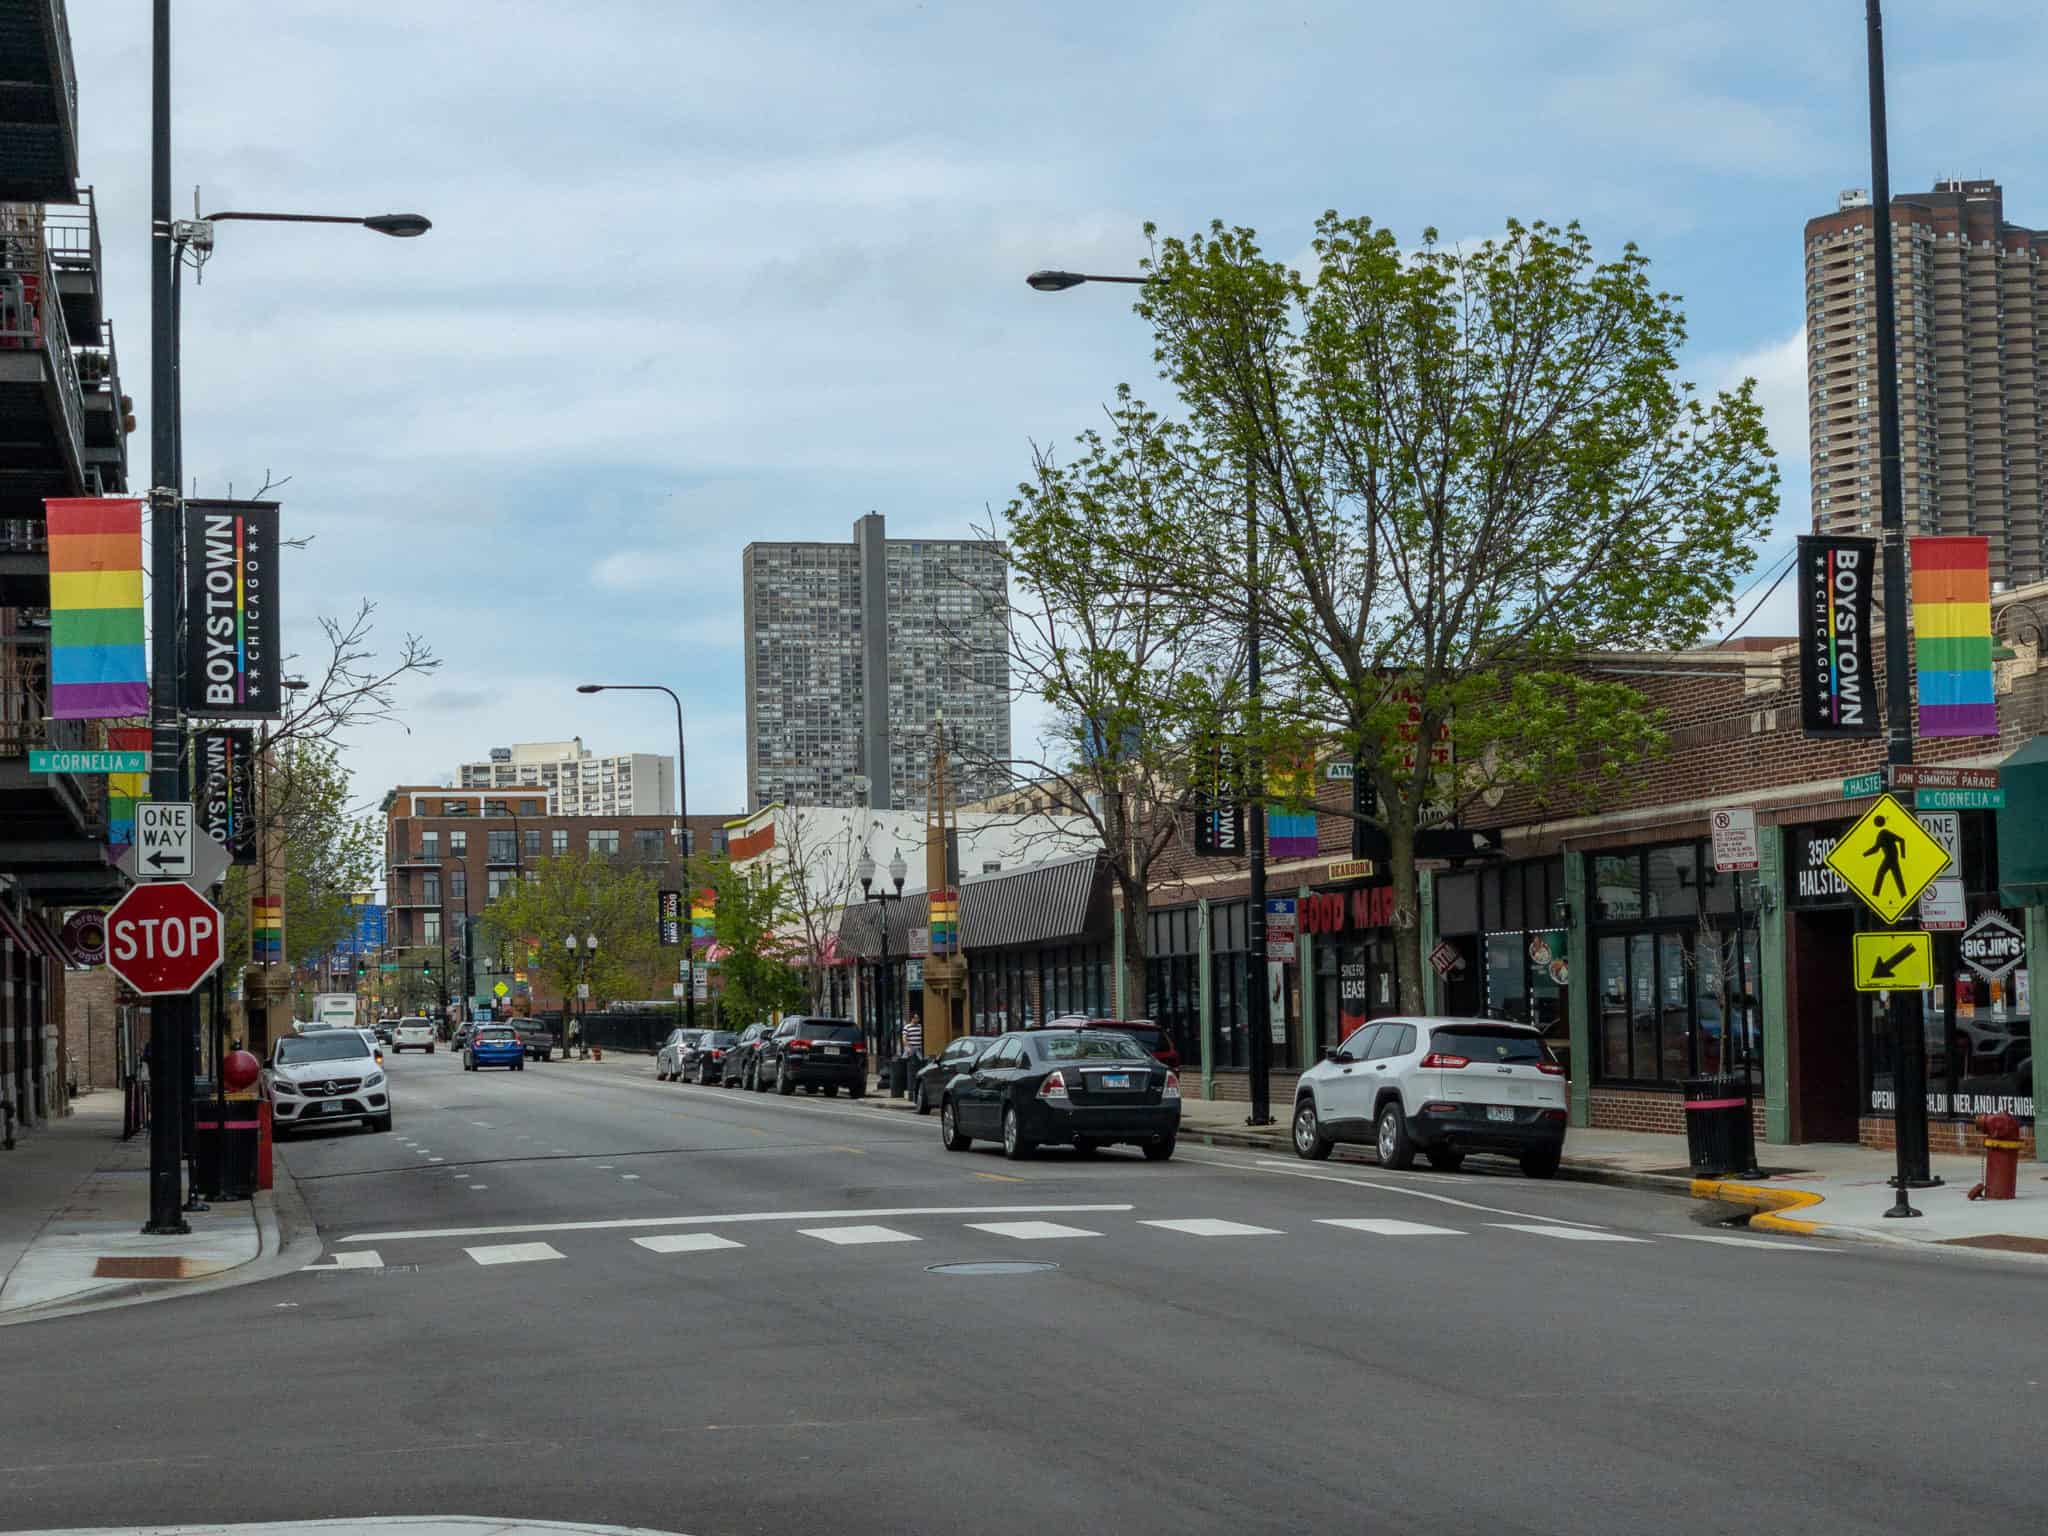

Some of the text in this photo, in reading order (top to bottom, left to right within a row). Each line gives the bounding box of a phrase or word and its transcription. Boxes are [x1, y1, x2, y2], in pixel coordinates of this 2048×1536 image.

[205, 515, 234, 704] BOYSTOWN
[247, 560, 259, 661] CHICAGO
[1815, 590, 1829, 684] CHICAGO
[1835, 549, 1864, 725] BOYSTOWN
[51, 754, 124, 771] CORNELIA
[129, 758, 140, 768] AV
[207, 737, 227, 843] OYSTOWN
[1850, 774, 1881, 794] HALSTE
[1896, 772, 1997, 789] JON SIMMONS PARADE
[1934, 791, 1989, 808] CORNELIA
[144, 810, 187, 827] ONE
[1922, 818, 1953, 833] ONE
[143, 830, 187, 847] WAY
[1331, 861, 1369, 878] DEARBORN
[1799, 868, 1848, 897] HALSTED
[1298, 886, 1393, 935] FOOD MAR
[114, 916, 213, 961] STOP
[1964, 937, 2020, 957] BIG JIM'S
[70, 947, 104, 963] yogur
[1974, 1094, 1992, 1113] AND
[1992, 1095, 2013, 1115] LATE
[2013, 1096, 2036, 1117] NIGH
